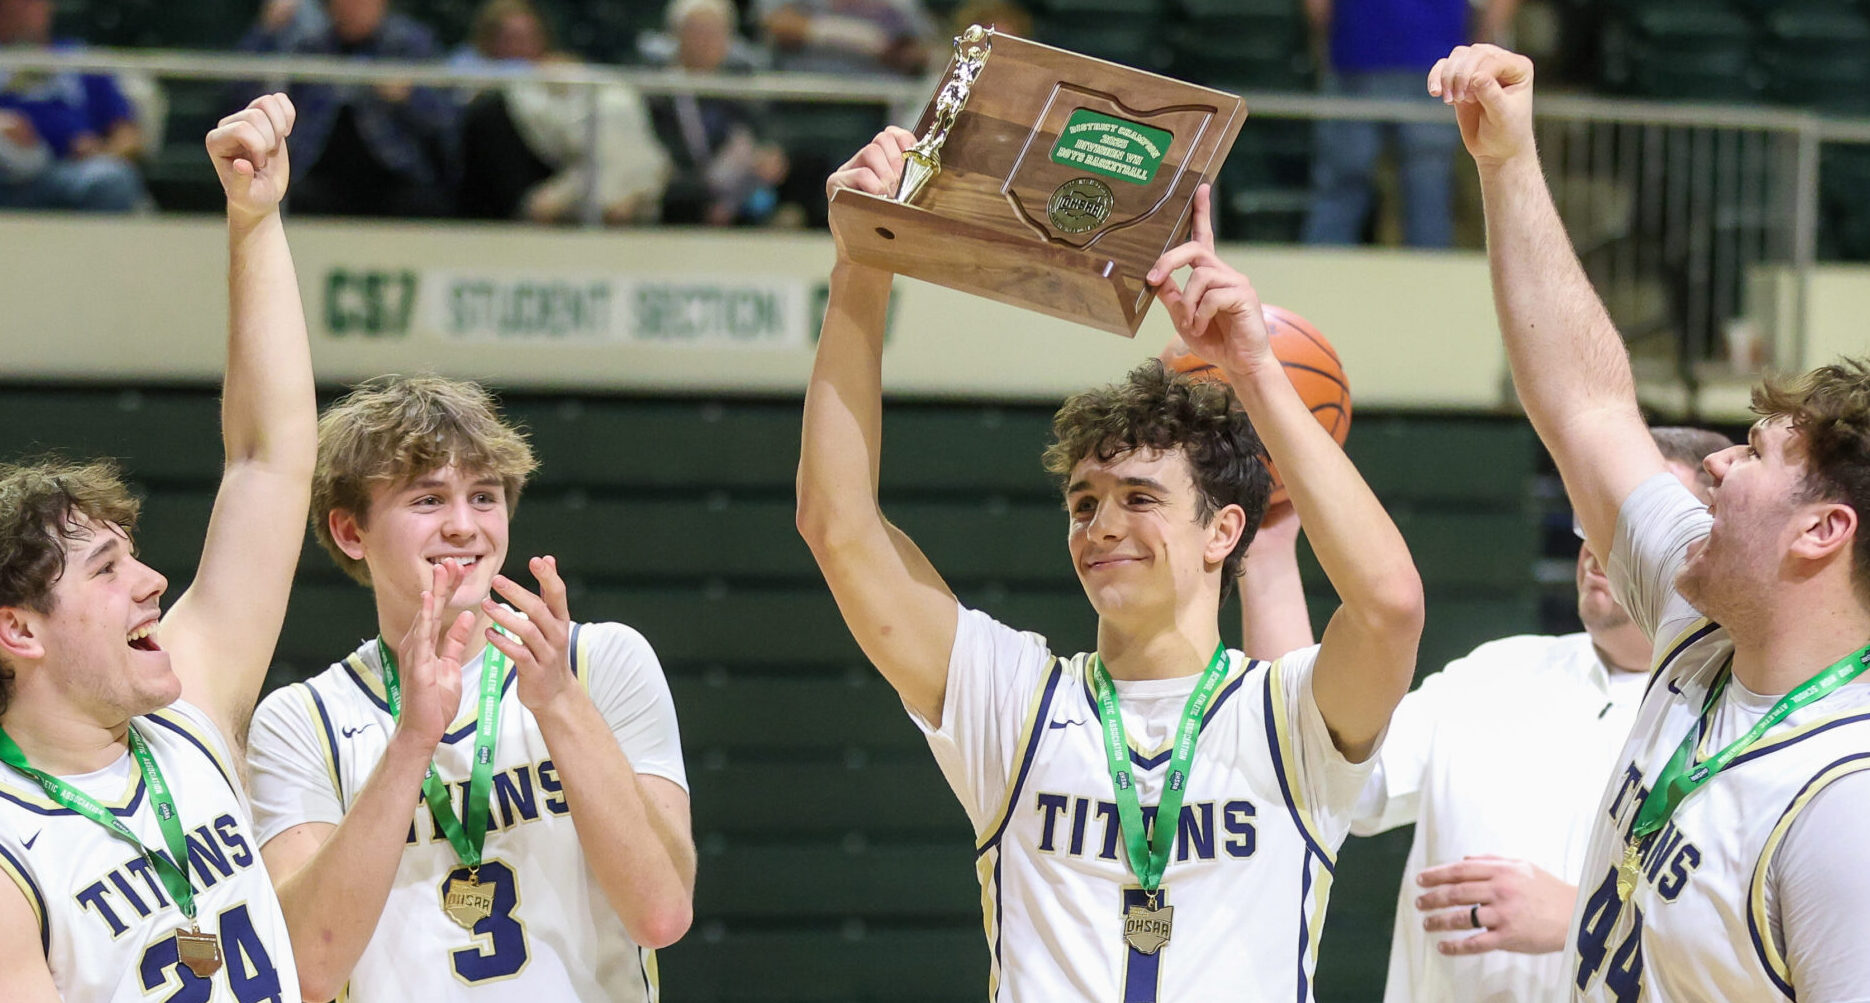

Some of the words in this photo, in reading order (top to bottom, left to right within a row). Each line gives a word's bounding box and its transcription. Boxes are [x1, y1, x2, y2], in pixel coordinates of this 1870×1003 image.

[1084, 154, 1148, 181] BASKETBALL
[74, 813, 253, 940] TITNS
[440, 859, 530, 985] 3
[1126, 919, 1169, 937] OHSAA
[1577, 864, 1645, 1003] 44
